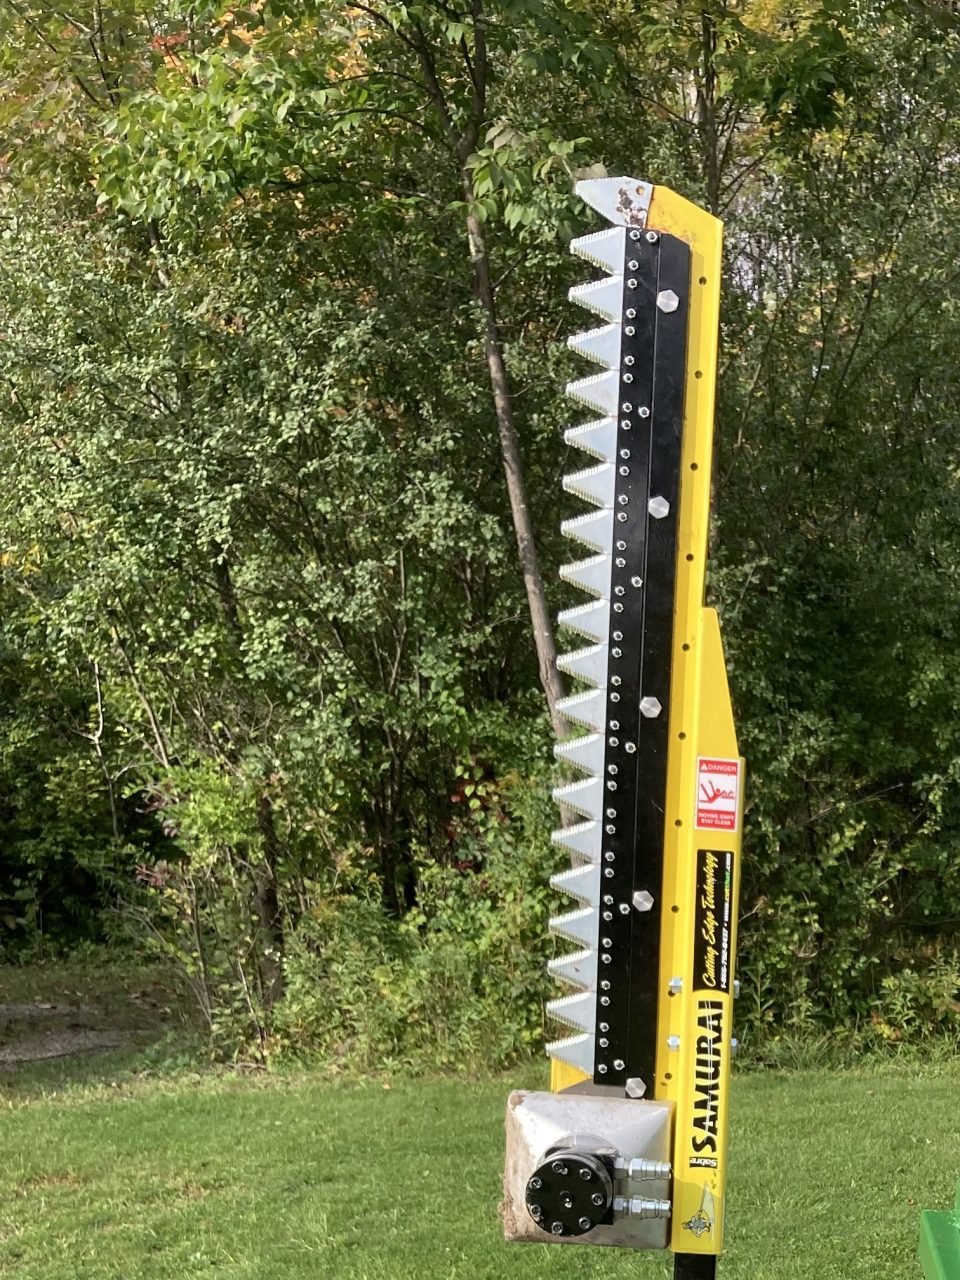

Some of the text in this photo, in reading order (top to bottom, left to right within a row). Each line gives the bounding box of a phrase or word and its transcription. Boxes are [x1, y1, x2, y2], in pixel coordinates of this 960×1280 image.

[707, 763, 736, 773] DANGER
[701, 852, 719, 988] Cutting Edge Technology
[691, 1000, 723, 1154] SAMURAI
[690, 1157, 718, 1167] Sabre
